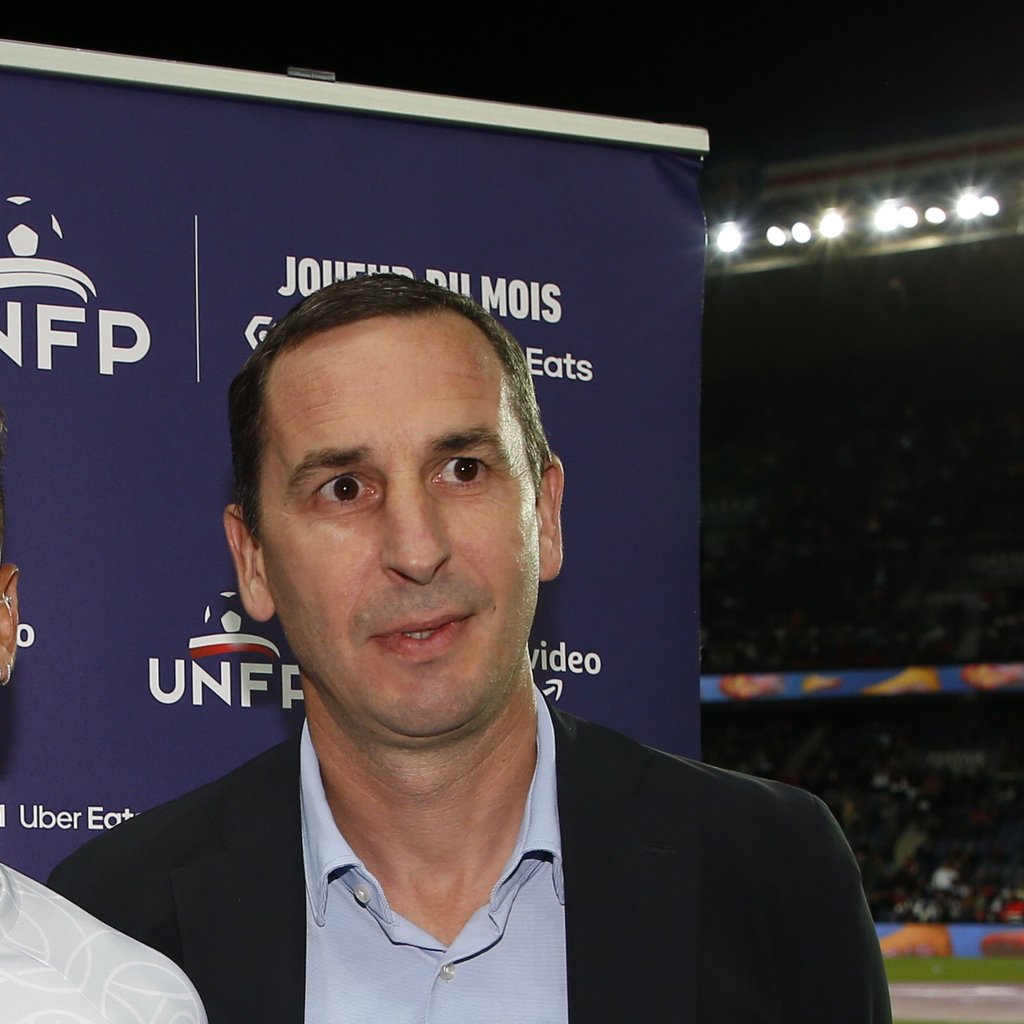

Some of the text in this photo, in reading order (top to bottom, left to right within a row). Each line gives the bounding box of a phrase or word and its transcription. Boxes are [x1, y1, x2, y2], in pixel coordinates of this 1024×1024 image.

[481, 275, 563, 324] MOIS
[526, 347, 594, 382] Eats
[20, 804, 82, 829] Uber
[88, 806, 142, 830] Eat
